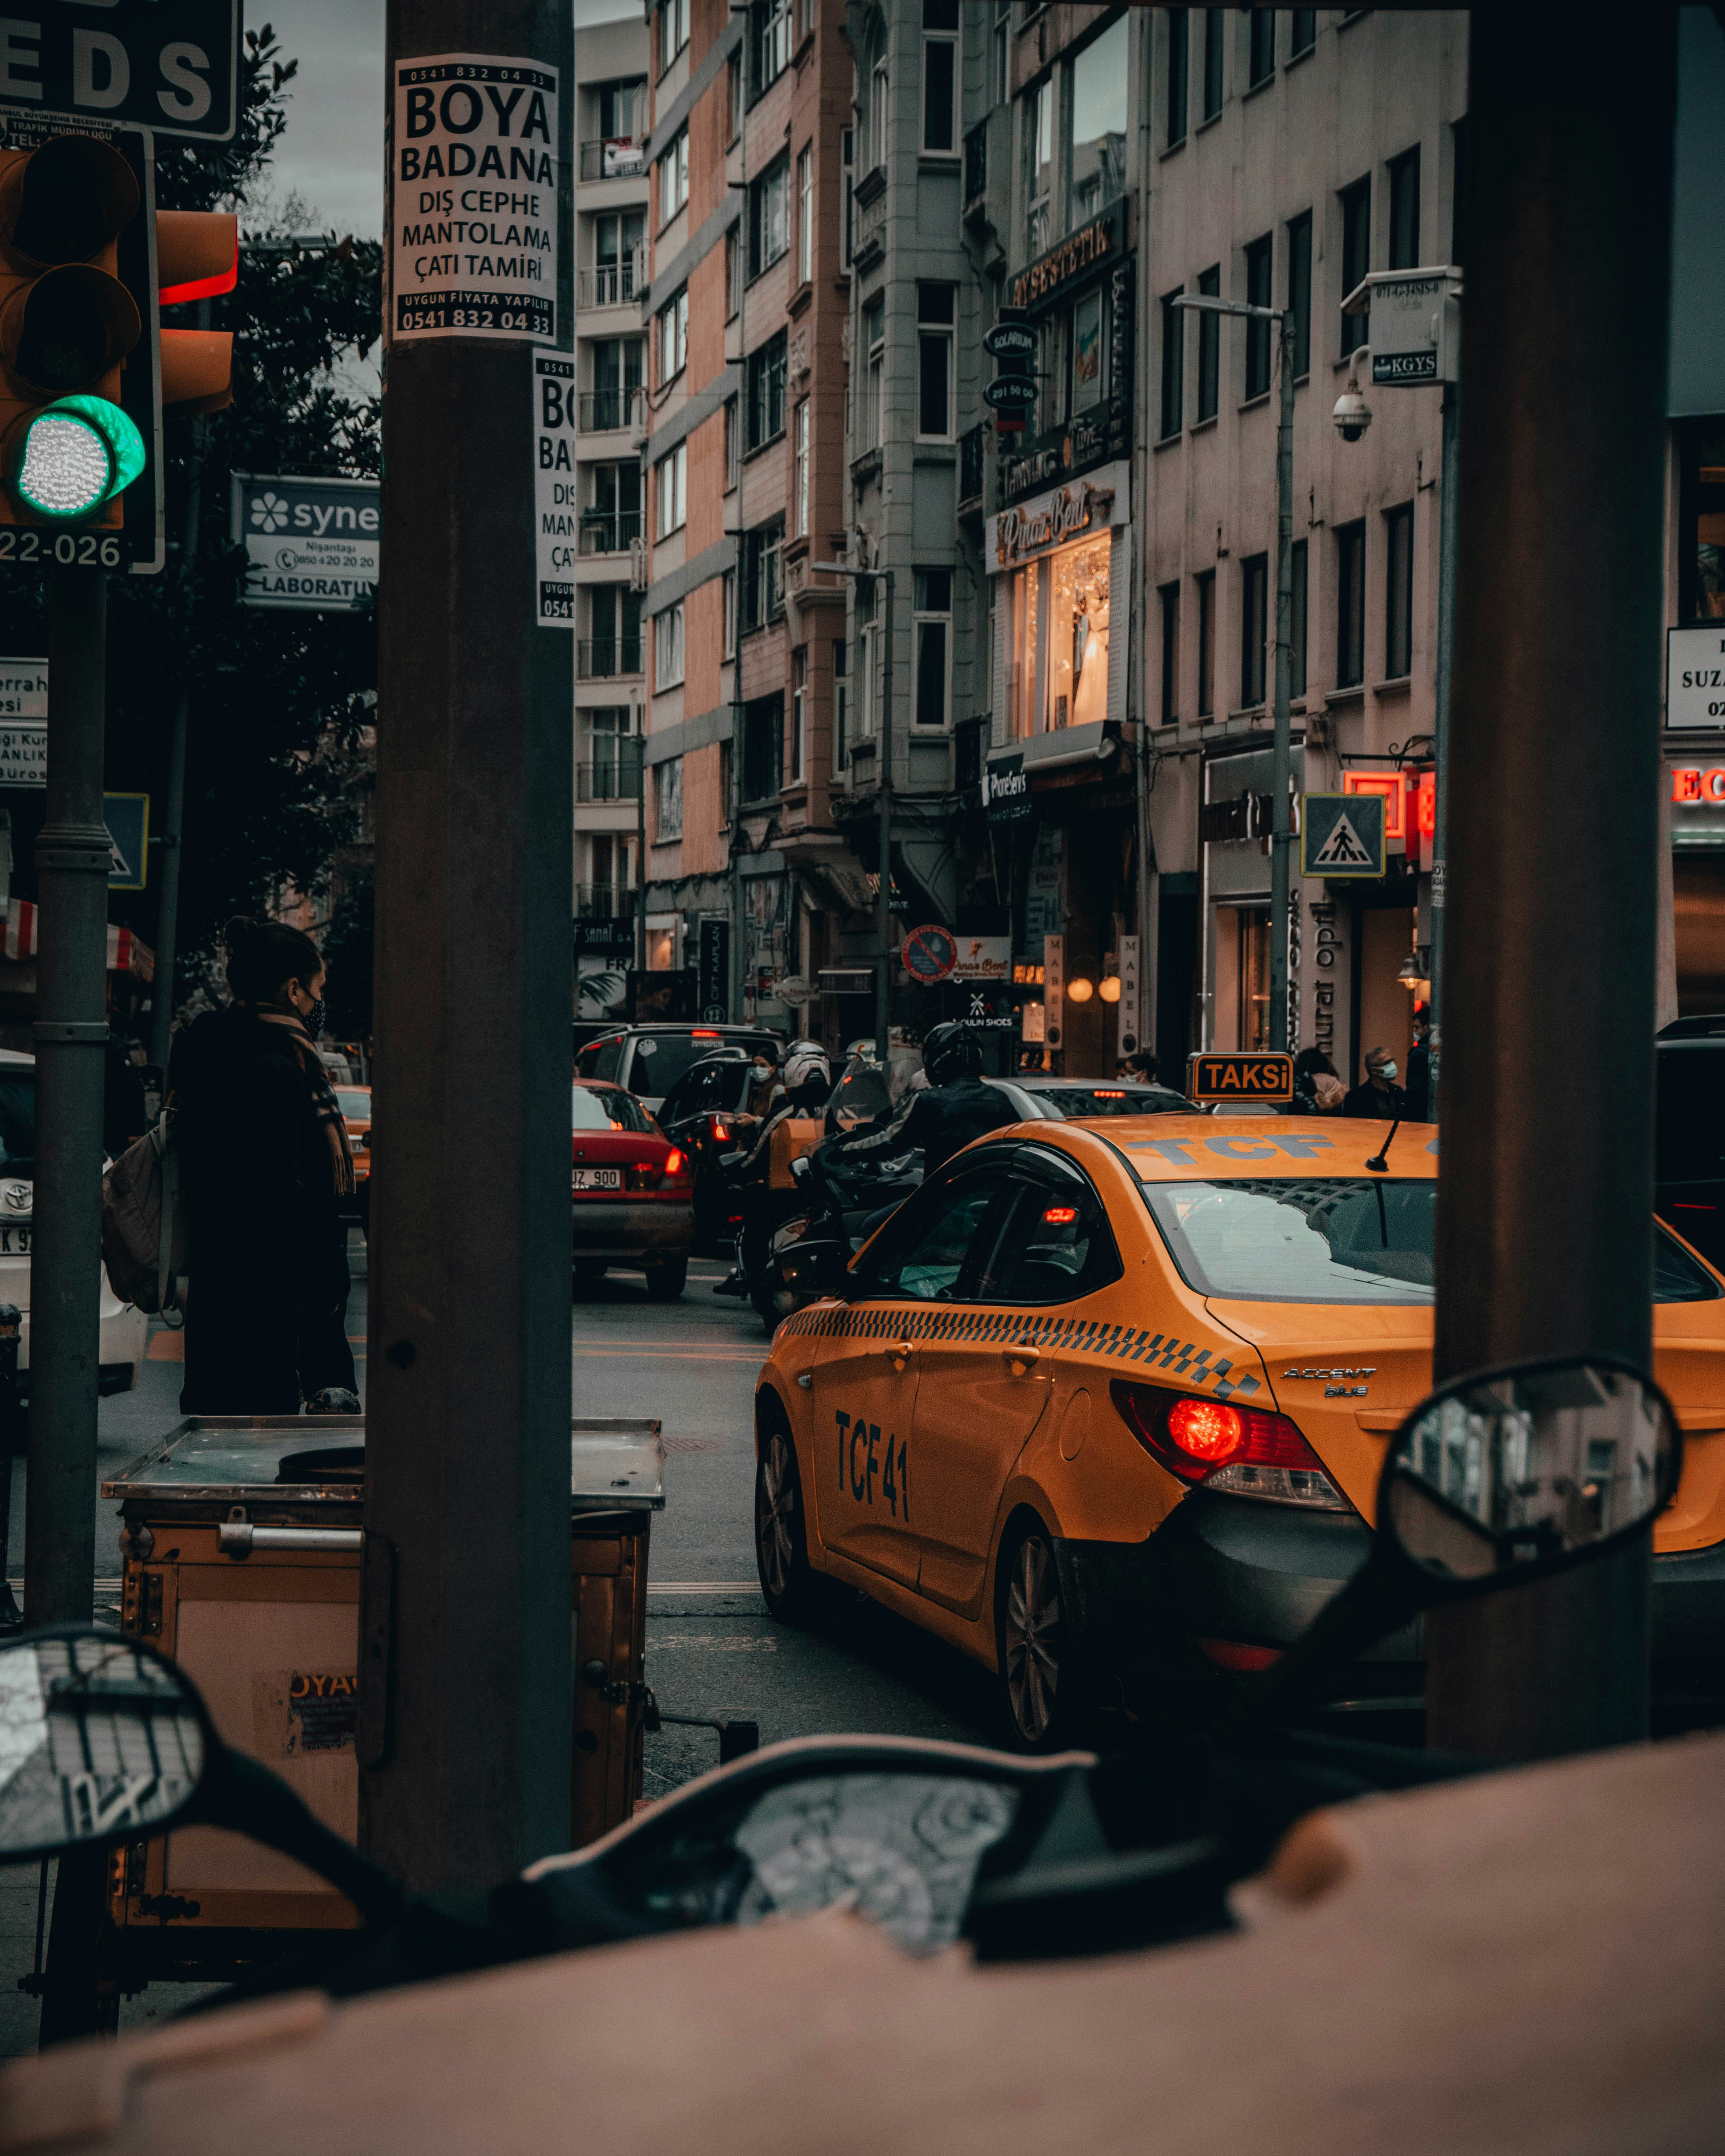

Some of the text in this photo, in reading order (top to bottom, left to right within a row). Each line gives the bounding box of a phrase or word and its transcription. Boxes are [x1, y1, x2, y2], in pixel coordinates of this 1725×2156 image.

[411, 67, 545, 86] 0541 832 04 33
[407, 83, 551, 145] BOYA
[11, 121, 47, 133] TRAFİK
[401, 143, 554, 188] BADANA
[420, 190, 540, 217] DIŞ CEPHE
[402, 221, 551, 252] MANTOLAMA
[415, 253, 542, 283] ÇATI TAMİRİ
[405, 291, 549, 311] UYGUN FİYATA YAPILIR
[402, 309, 549, 334] 0541 832 04 33
[544, 362, 570, 376] 0541
[1392, 356, 1436, 373] KGYS
[540, 436, 575, 472] BA
[293, 504, 379, 537] syne
[306, 542, 356, 554] Nişantaşı
[293, 554, 374, 567] 0850 420 20 20
[0, 676, 47, 692] rrah
[1125, 941, 1136, 1030] MABEL
[985, 1018, 1012, 1026] SHOES
[1125, 1135, 1336, 1166] TCF
[594, 1171, 617, 1184] 900
[1280, 1368, 1377, 1379] ACCENT
[1324, 1383, 1369, 1398] blue
